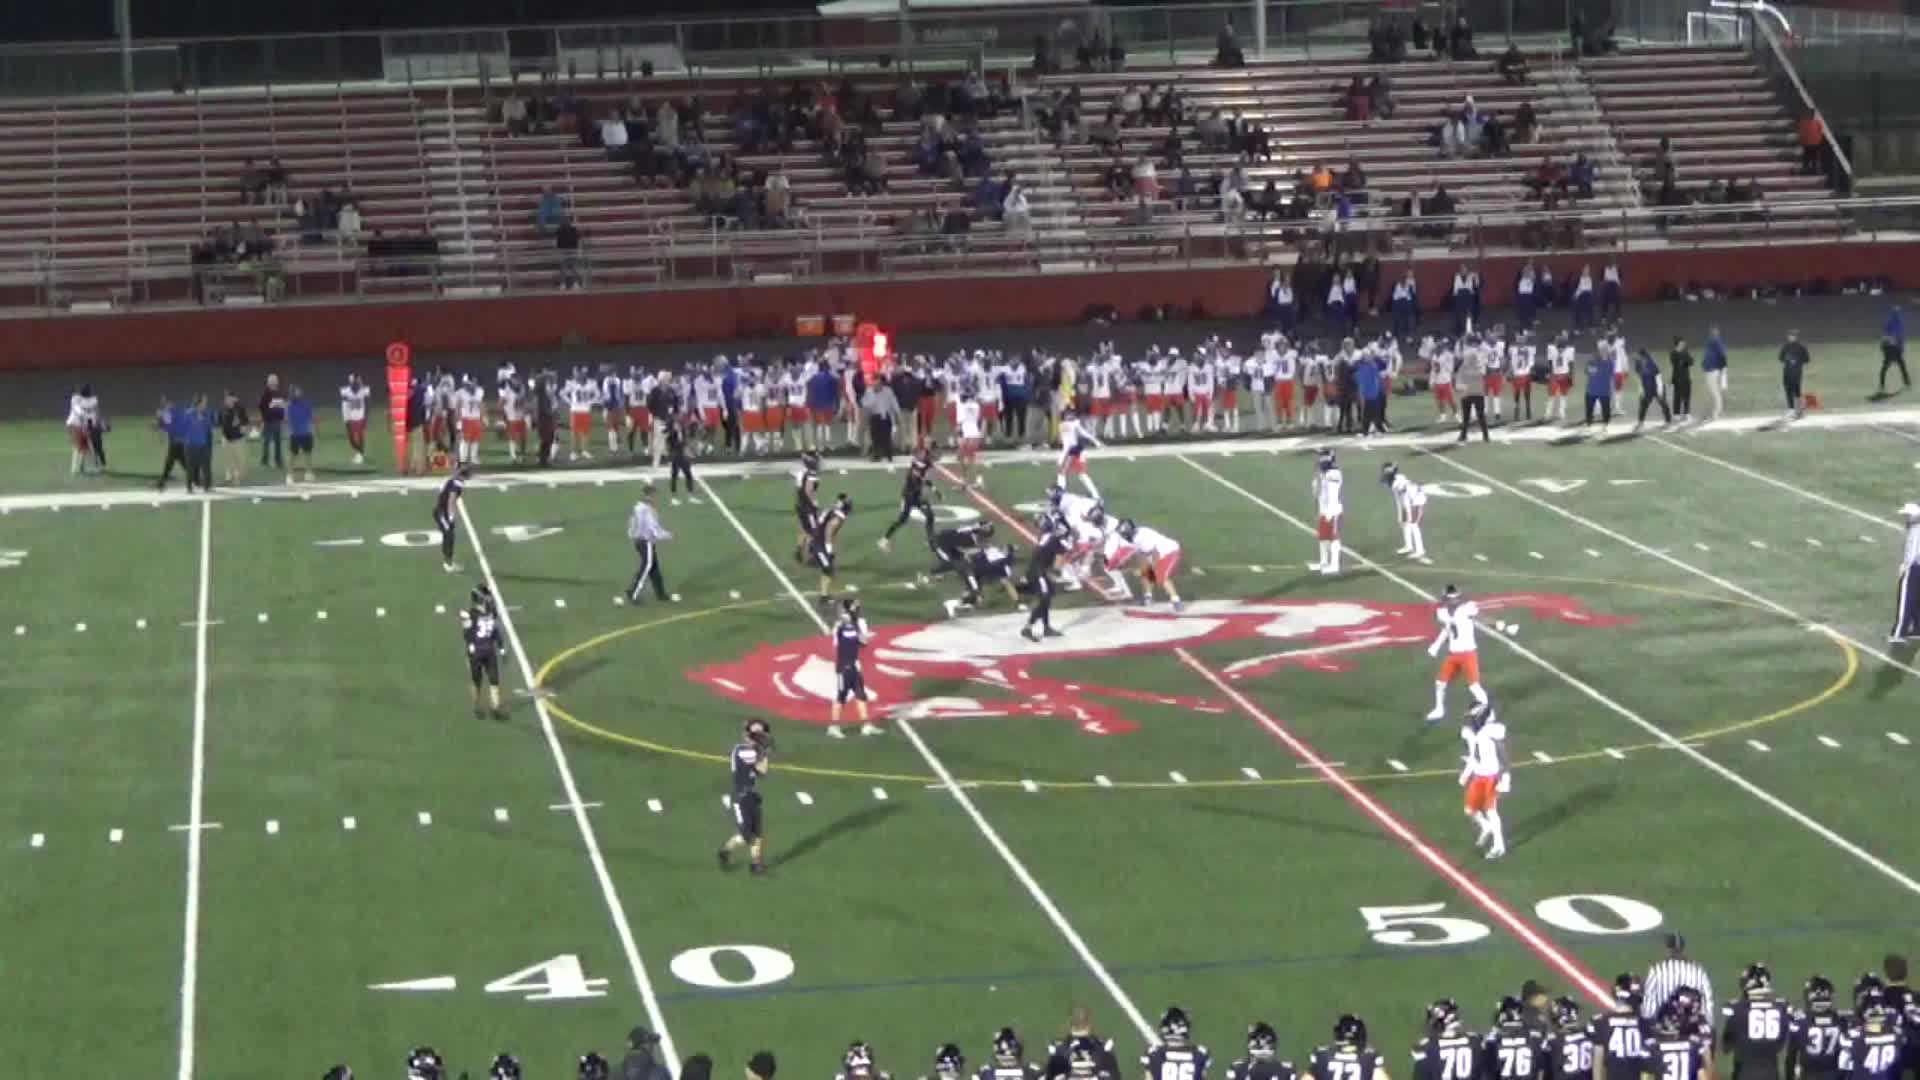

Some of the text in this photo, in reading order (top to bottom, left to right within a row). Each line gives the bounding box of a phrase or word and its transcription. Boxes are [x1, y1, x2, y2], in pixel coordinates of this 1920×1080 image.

[1748, 1009, 1780, 1039] 66
[1608, 1027, 1641, 1058] 40
[1806, 1026, 1840, 1055] 37
[1439, 1047, 1472, 1080] 70
[1498, 1047, 1532, 1077] 76
[1563, 1041, 1593, 1073] 36
